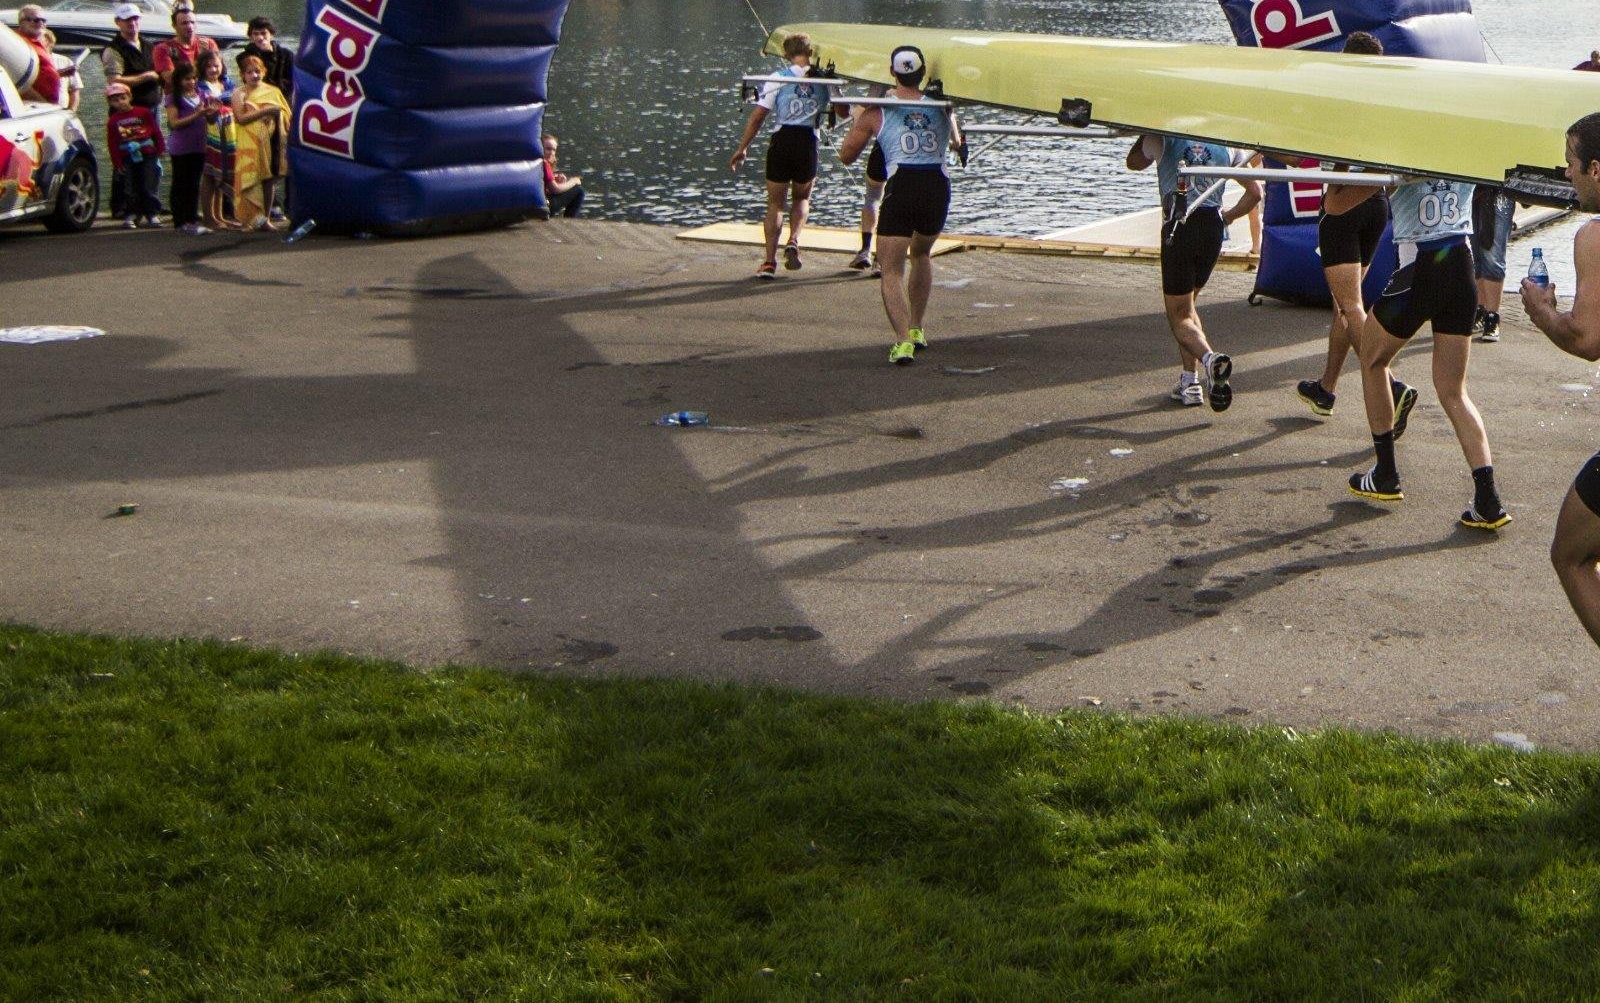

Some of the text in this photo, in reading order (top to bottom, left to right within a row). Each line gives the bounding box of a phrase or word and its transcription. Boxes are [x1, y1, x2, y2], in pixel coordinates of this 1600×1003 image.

[300, 6, 378, 157] Red
[900, 130, 939, 154] 03
[1418, 192, 1460, 227] 03
